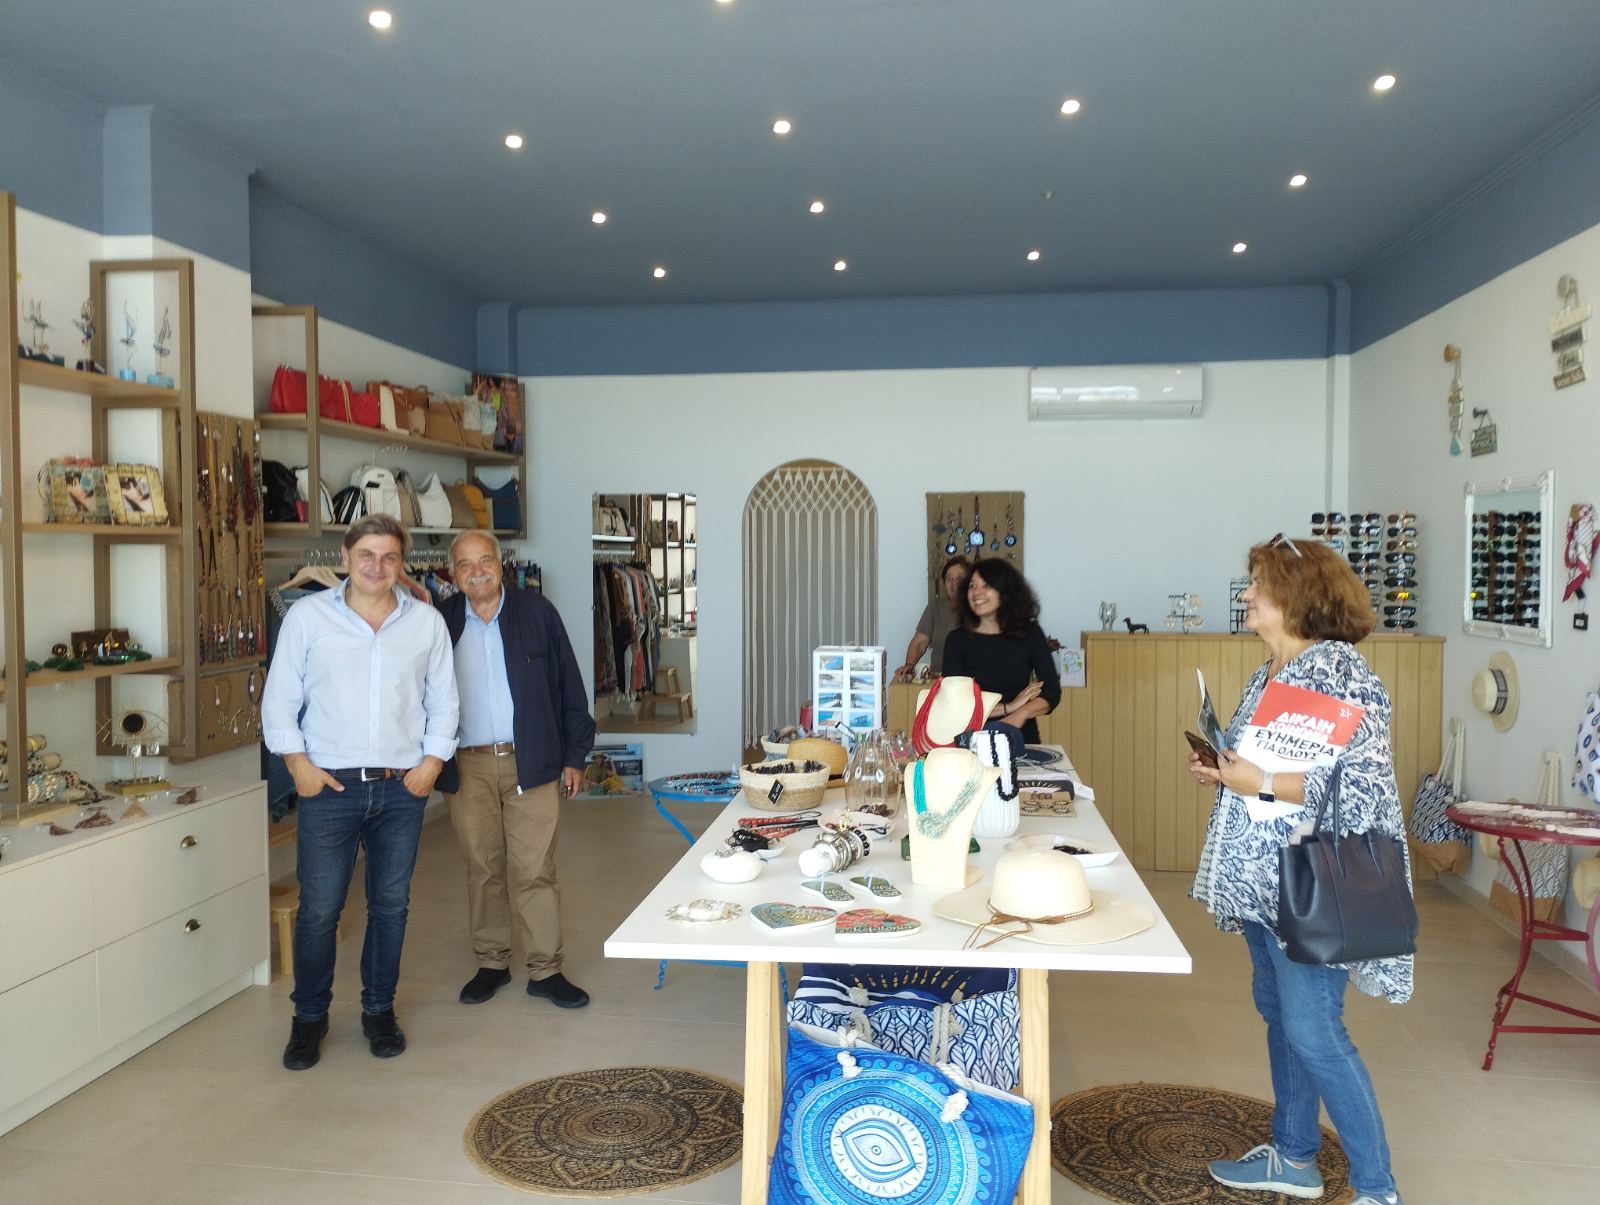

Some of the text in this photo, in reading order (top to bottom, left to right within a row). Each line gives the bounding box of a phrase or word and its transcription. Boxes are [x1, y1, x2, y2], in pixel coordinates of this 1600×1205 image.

[1275, 711, 1336, 734] ΔΙΚΑΙΗ
[1255, 728, 1335, 756] ΕΥΗΜΕΡΙΑ
[1256, 739, 1319, 760] ΓΙΑ ΟΛΟΥΣ
